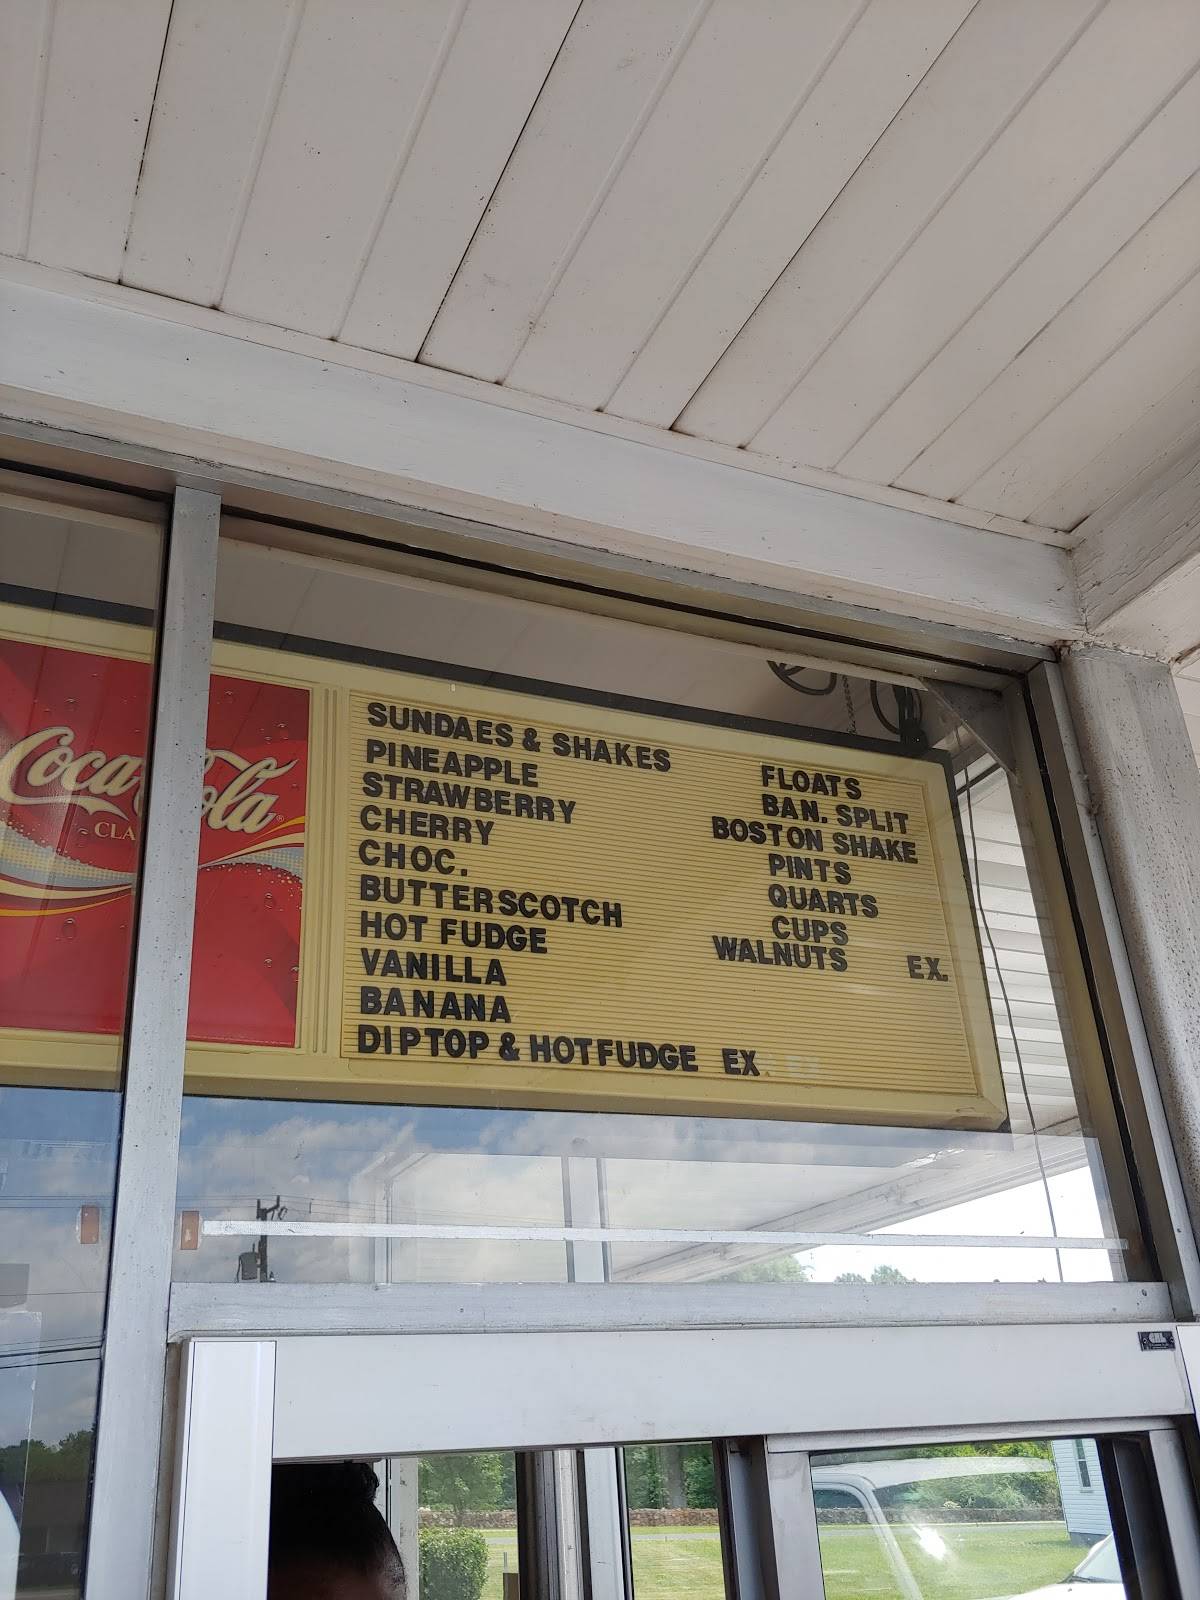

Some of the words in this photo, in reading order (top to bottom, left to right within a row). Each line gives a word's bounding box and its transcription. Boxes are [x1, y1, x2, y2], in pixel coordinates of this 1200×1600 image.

[367, 701, 514, 748] SUNDAES
[522, 727, 541, 753] &
[552, 732, 671, 773] SHAKES
[366, 739, 539, 788] PINEAPPLE
[761, 764, 862, 800] FLOATS
[362, 771, 576, 824] STRAWBERRY
[762, 794, 828, 824] BAN.
[836, 805, 909, 835] SPLIT
[360, 804, 494, 845] CHERRY
[712, 816, 824, 853] BOSTON
[832, 832, 918, 864] SHAKE
[358, 839, 468, 877] CHOC.
[768, 853, 852, 885] PINTS
[360, 874, 623, 928] BUTTERSCOTCH
[768, 884, 879, 919] QUARTS
[360, 910, 428, 942] HOT
[440, 918, 548, 954] FUDGE
[771, 915, 849, 946] CUPS
[360, 948, 507, 986] VANILLA
[712, 935, 848, 973] WALNUTS
[907, 955, 949, 982] EX.
[360, 985, 512, 1024] BANANA
[499, 1032, 520, 1061] &
[722, 1048, 760, 1076] EX
